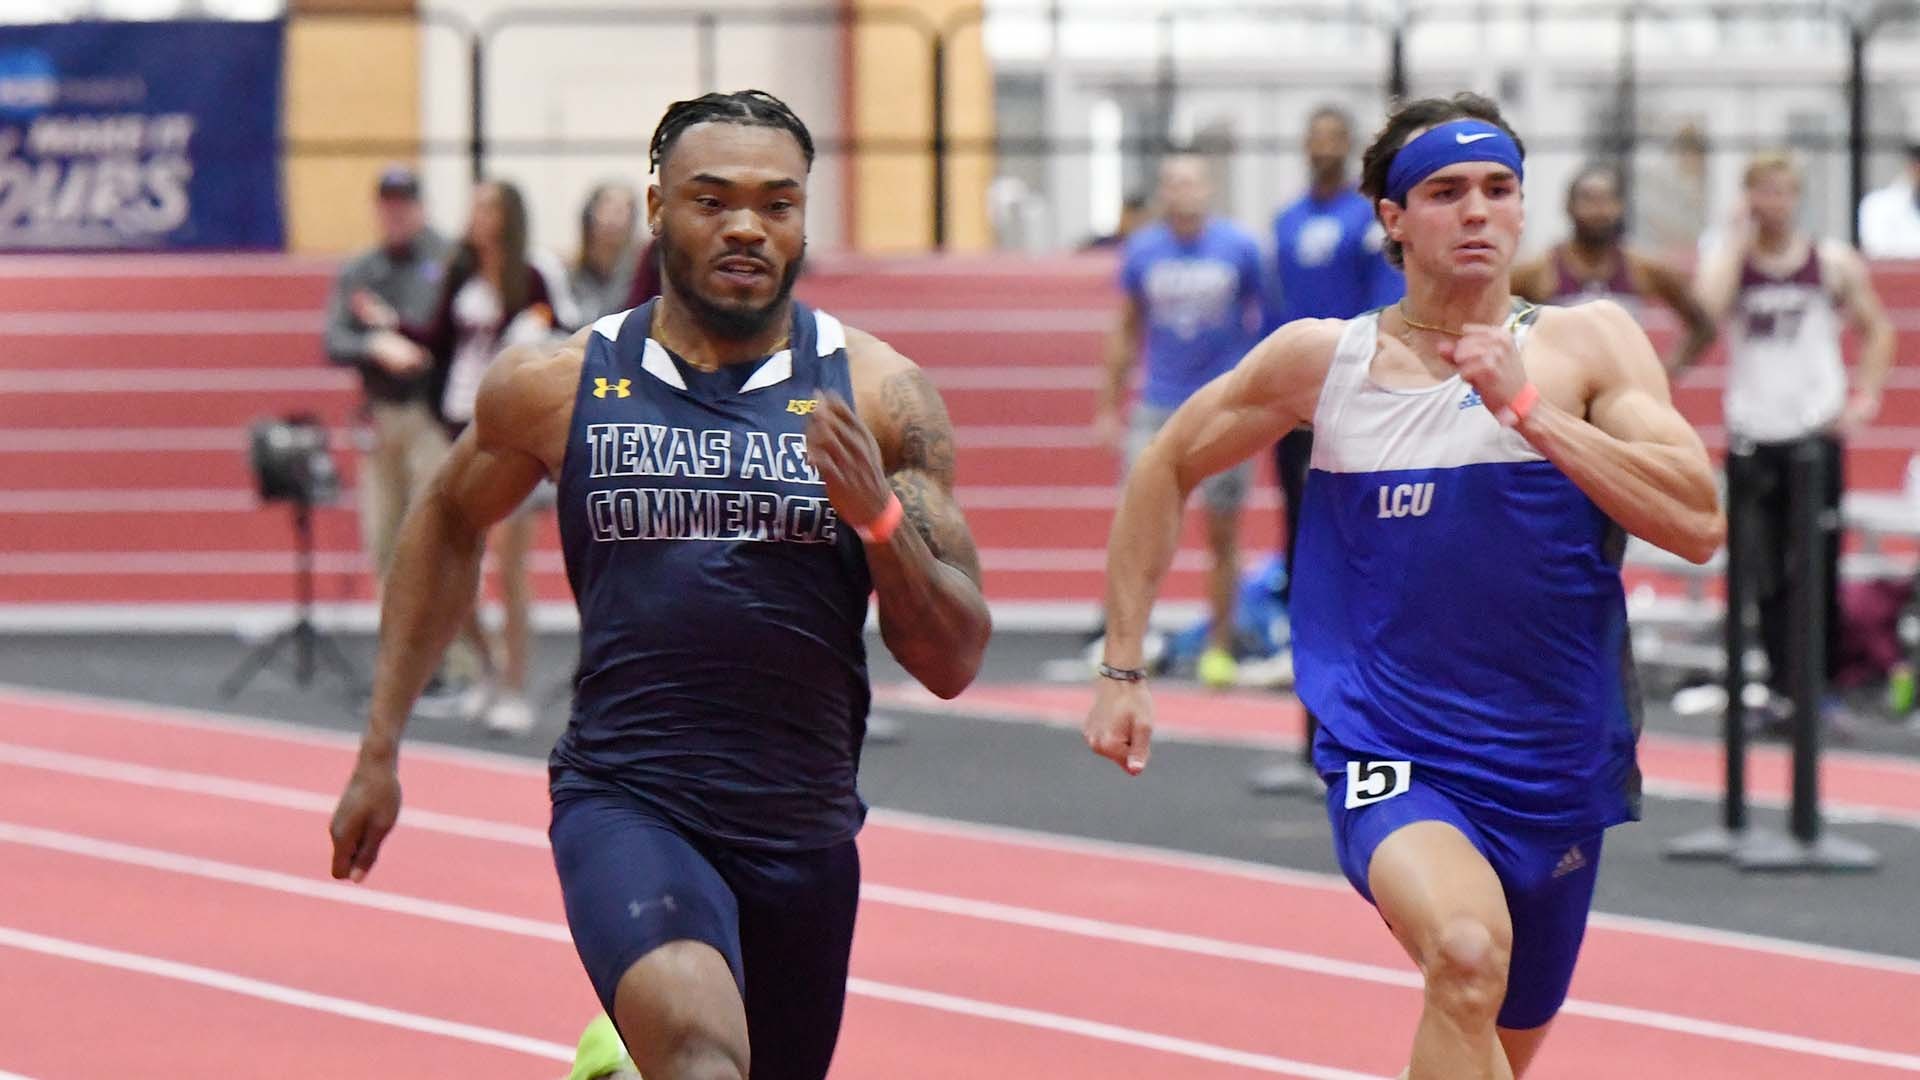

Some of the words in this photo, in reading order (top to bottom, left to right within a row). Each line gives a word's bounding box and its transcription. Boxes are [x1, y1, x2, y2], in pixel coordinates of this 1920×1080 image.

[586, 423, 731, 479] TEXAS
[740, 431, 827, 485] A&
[586, 487, 838, 545] COMMERCE
[1377, 482, 1436, 519] LCU
[1356, 761, 1397, 800] 5
